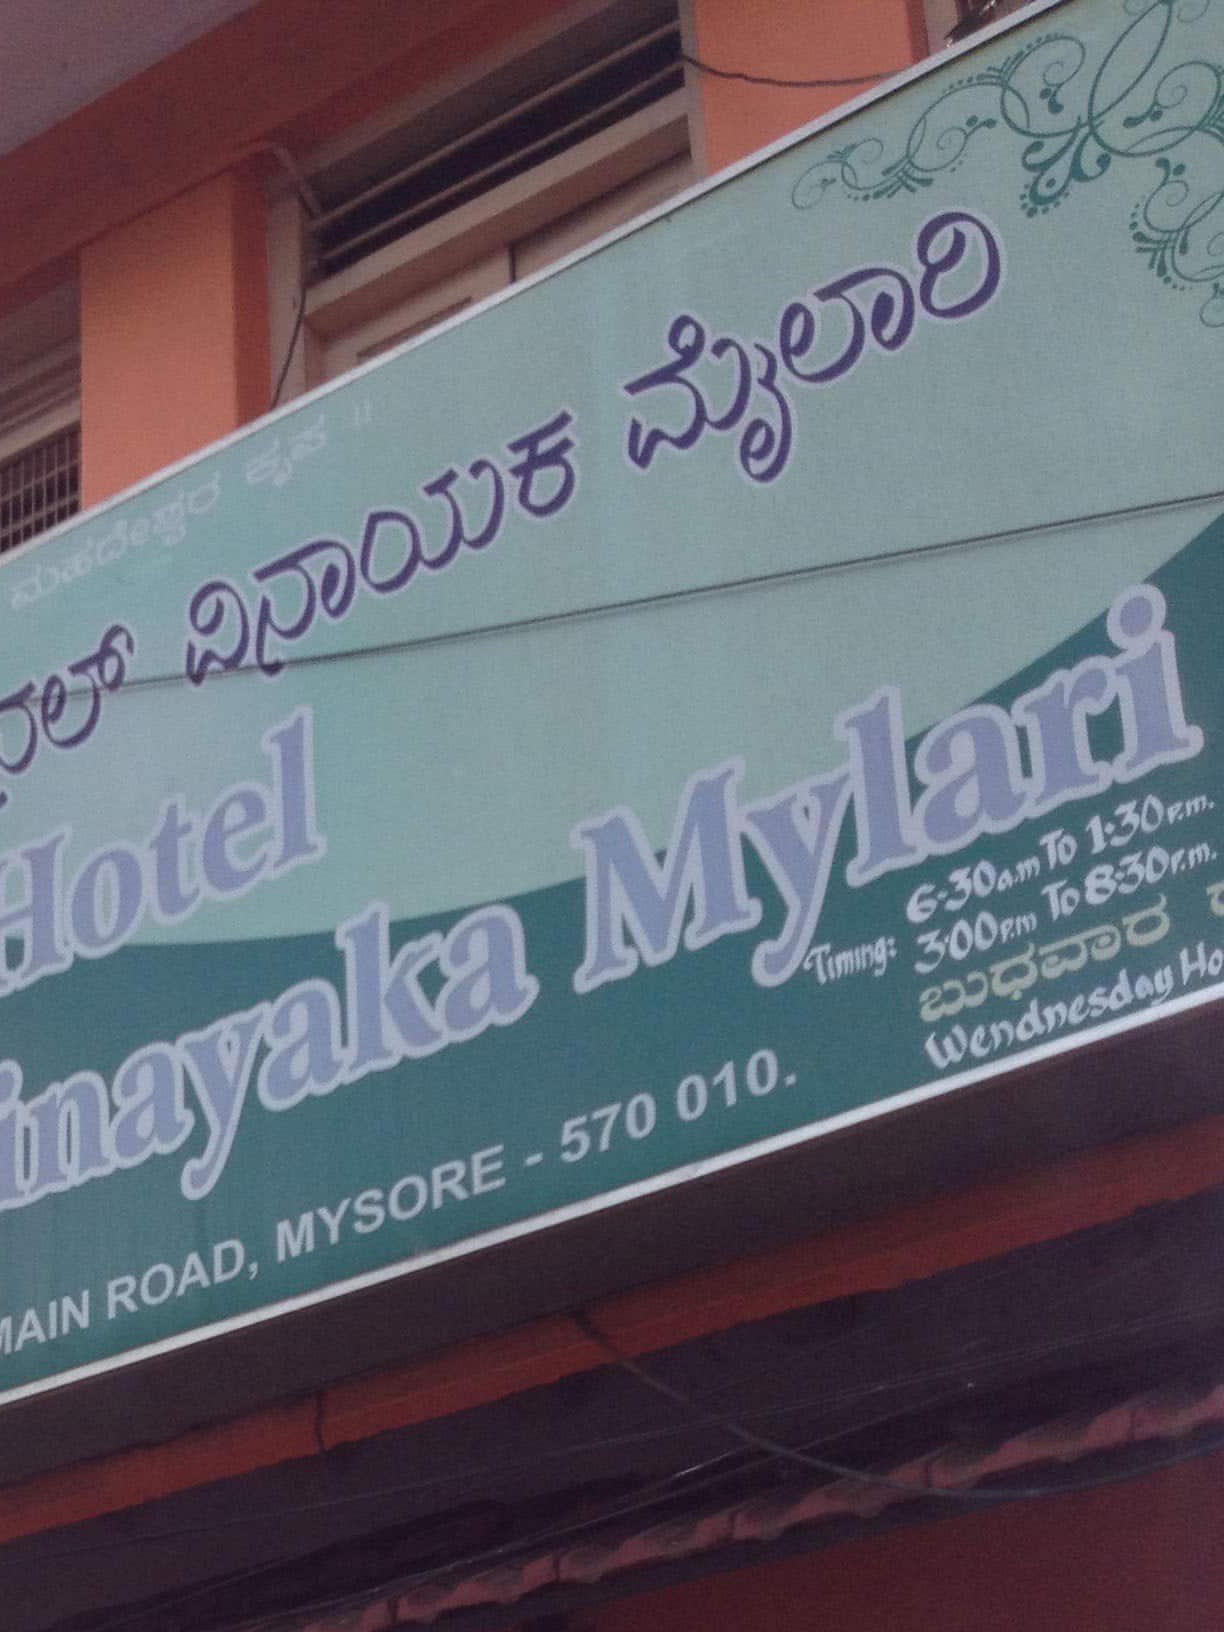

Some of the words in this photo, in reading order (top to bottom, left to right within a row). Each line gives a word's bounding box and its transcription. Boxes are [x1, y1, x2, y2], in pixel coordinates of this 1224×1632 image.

[185, 409, 576, 686] ವಿನಾಯಕ
[623, 211, 1001, 484] ಮೈಲಾರಿ
[571, 582, 1204, 995] Mylari
[1039, 828, 1078, 871] To
[803, 936, 897, 986] Timing:
[1041, 879, 1081, 922] To
[919, 893, 1170, 1023] ಬುಧವಾರ
[924, 966, 1174, 1069] Wendnesday
[107, 1238, 260, 1320] ROAD,
[276, 1143, 507, 1262] MYSORE
[560, 1091, 658, 1163] 570
[675, 1048, 797, 1121] 010.
